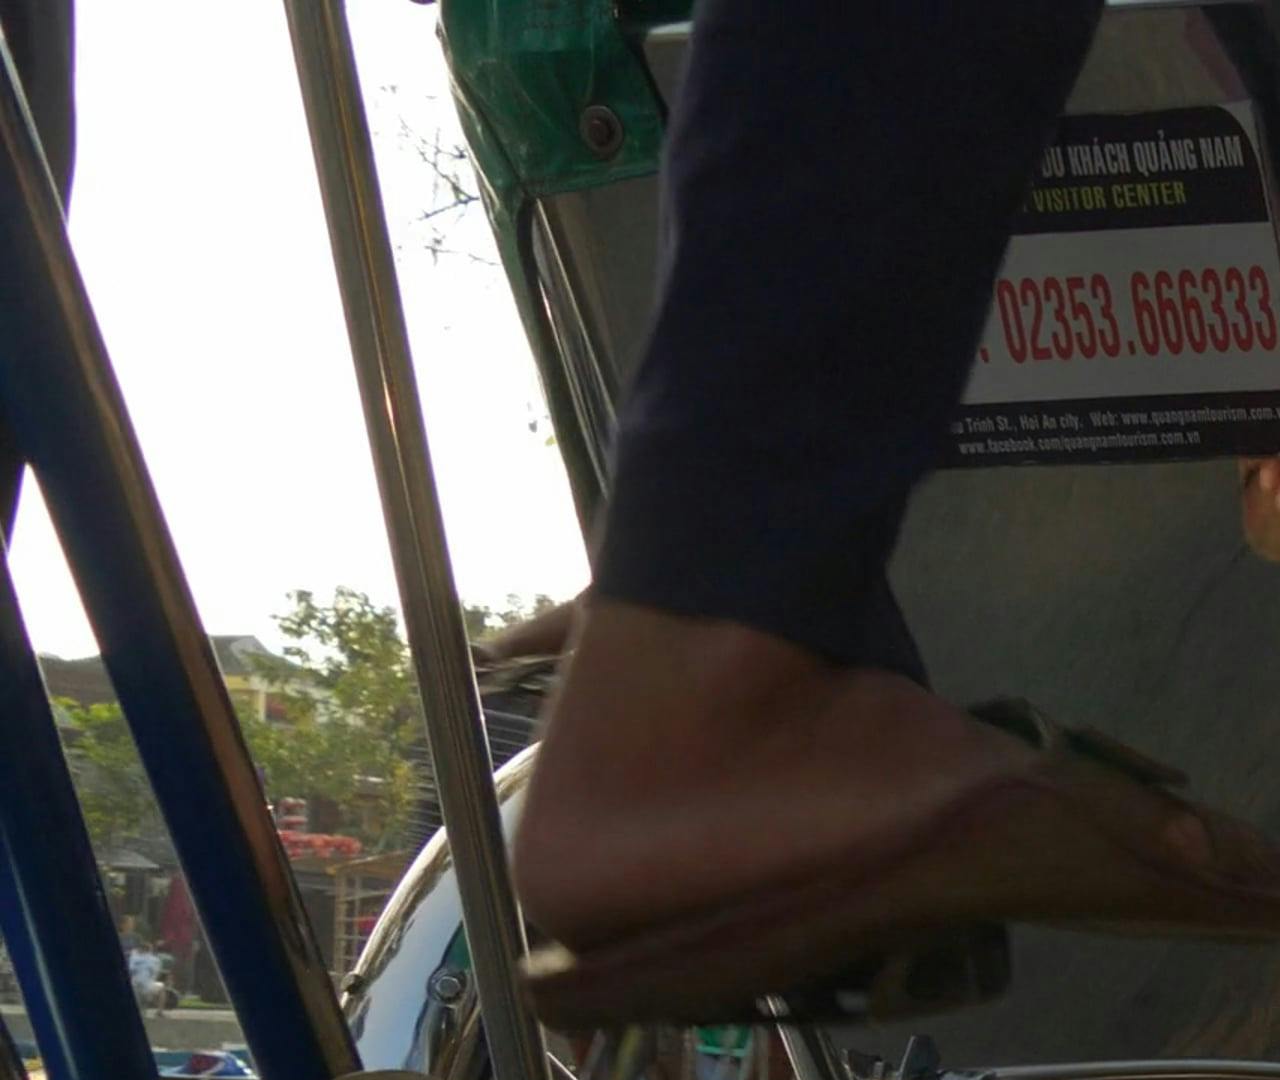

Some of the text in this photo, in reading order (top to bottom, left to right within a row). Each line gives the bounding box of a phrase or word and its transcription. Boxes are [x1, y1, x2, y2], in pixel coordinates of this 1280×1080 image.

[1068, 137, 1131, 177] KHÁCH
[1133, 129, 1200, 177] QUẢNG
[1200, 135, 1244, 169] NAM
[1032, 180, 1187, 212] VISITOR CENTER
[996, 264, 1278, 364] 02353.666333
